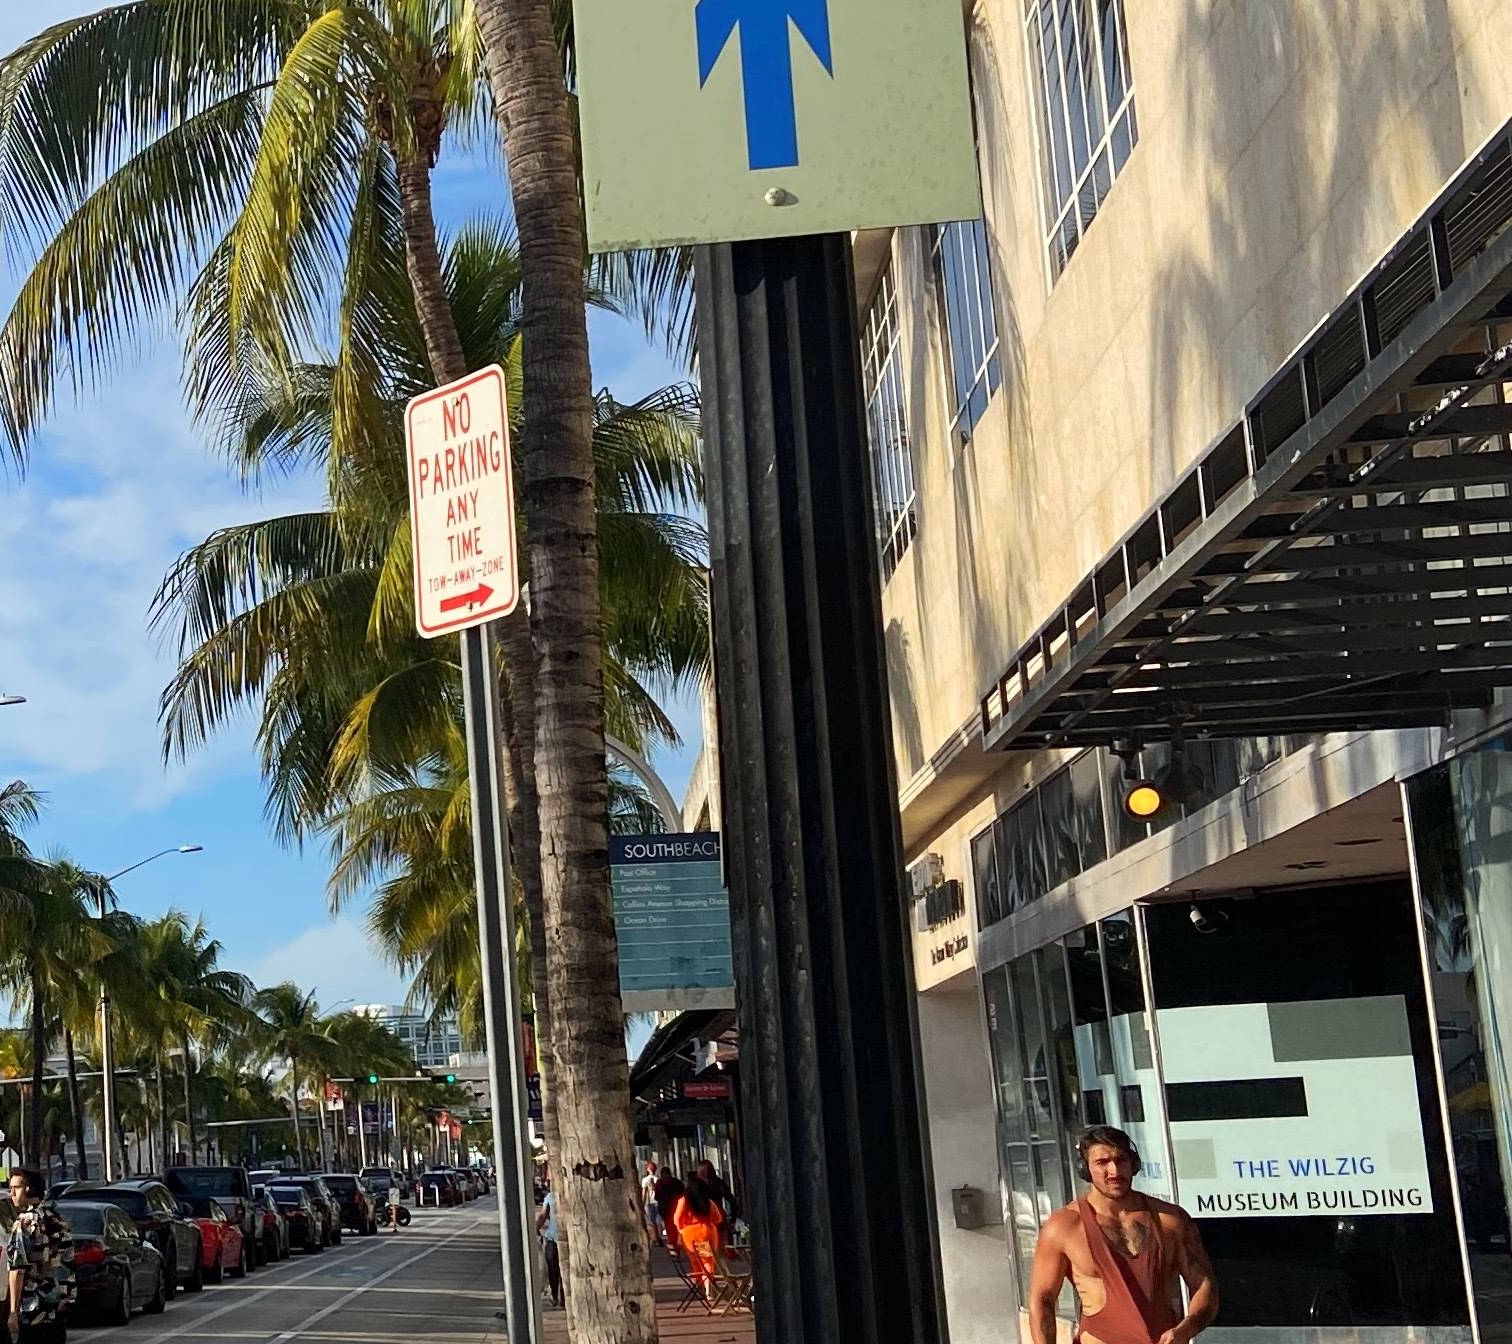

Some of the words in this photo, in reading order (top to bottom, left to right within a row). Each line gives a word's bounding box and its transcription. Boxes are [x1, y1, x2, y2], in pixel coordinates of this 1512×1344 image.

[442, 392, 471, 441] NO
[418, 431, 501, 499] PARKING
[446, 488, 479, 528] ANY
[447, 526, 483, 564] TIME
[428, 555, 505, 593] TOW-AWAY-ZONE
[634, 867, 657, 876] Office
[1232, 1160, 1281, 1179] THE
[1288, 1156, 1376, 1177] WILZIG
[1196, 1191, 1299, 1212] MUSEUM
[1307, 1188, 1423, 1209] BUILDING
